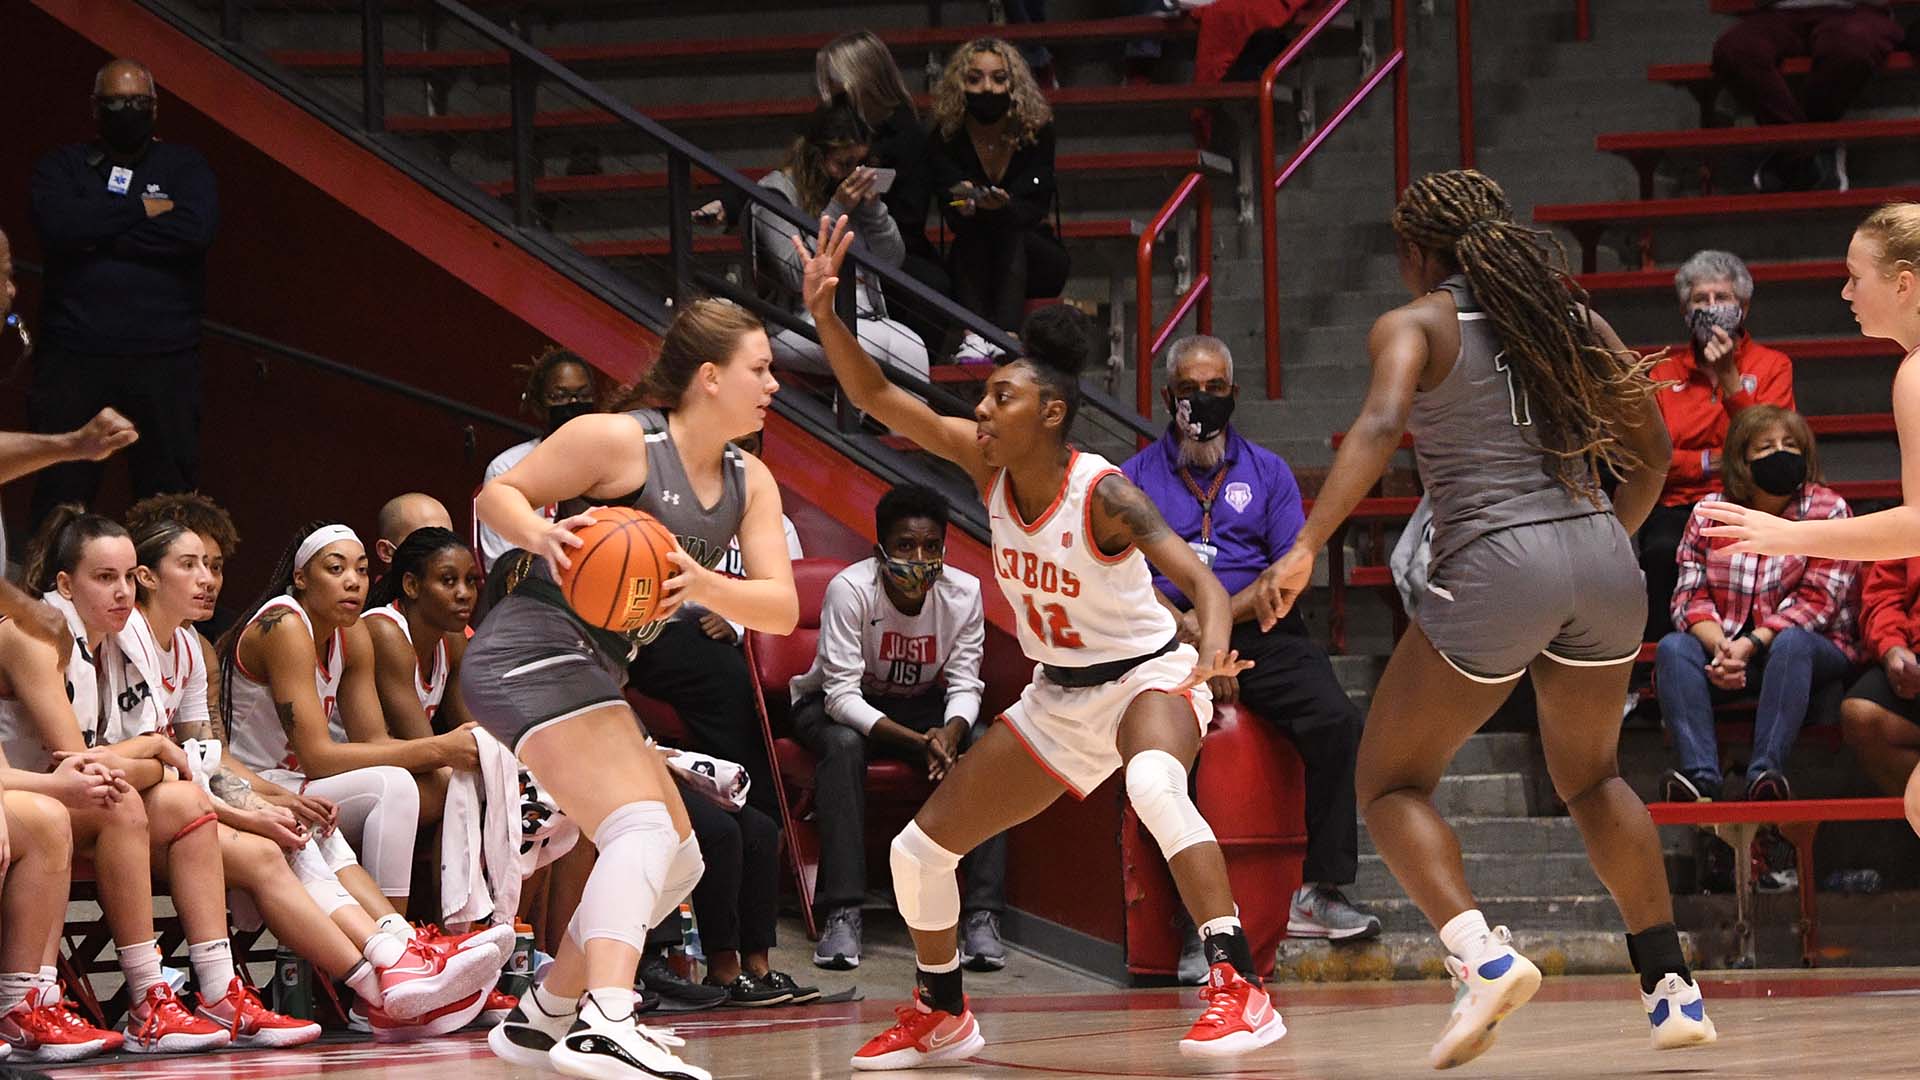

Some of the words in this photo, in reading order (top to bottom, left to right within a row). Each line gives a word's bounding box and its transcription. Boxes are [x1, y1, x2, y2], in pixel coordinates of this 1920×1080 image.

[993, 543, 1081, 599] LOBOS
[1021, 593, 1088, 649] 12
[886, 633, 930, 663] JUST
[892, 661, 918, 685] US
